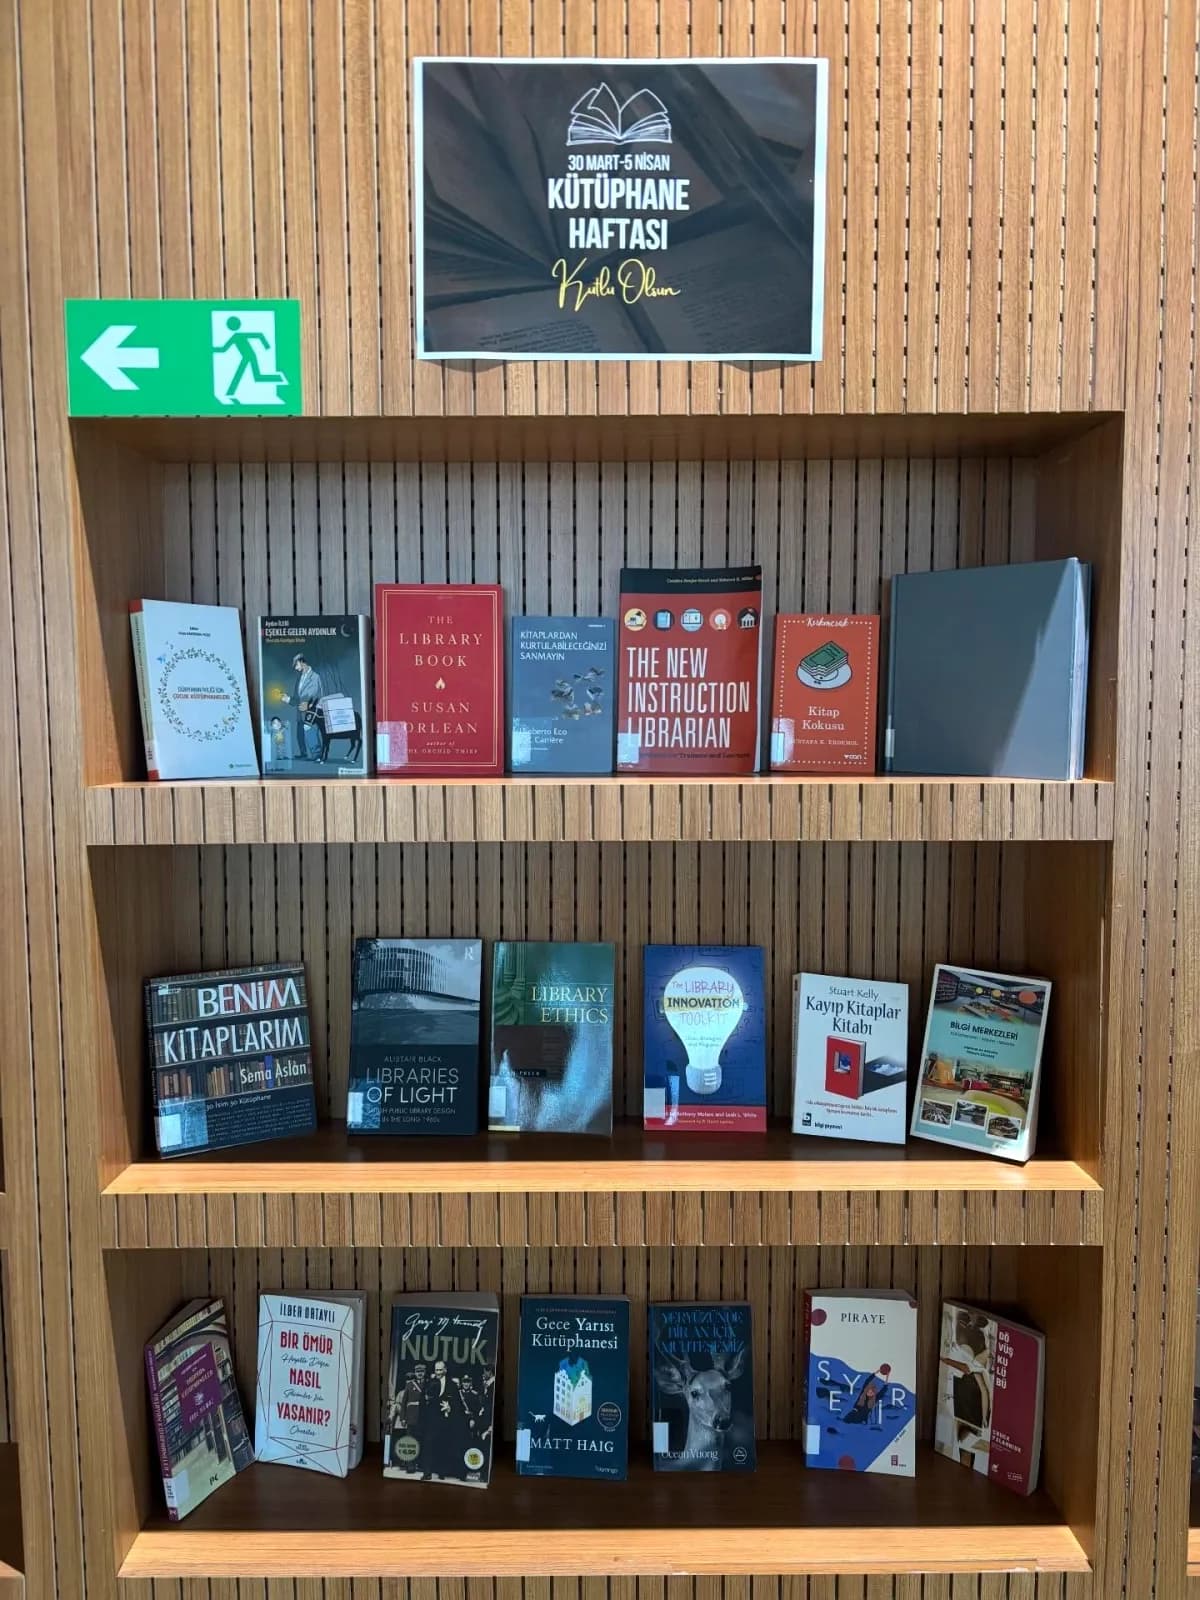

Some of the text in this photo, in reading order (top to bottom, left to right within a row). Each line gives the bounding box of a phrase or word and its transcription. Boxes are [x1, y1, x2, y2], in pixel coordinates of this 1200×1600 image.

[568, 152, 670, 171] 30 MART-5 NİSAN
[547, 173, 690, 211] KÜTÜPHANE
[568, 217, 668, 250] HAFTASI
[551, 257, 681, 312] Kutlu Olsun
[427, 615, 454, 624] THE
[288, 628, 308, 636] GELEN
[308, 628, 337, 636] AYDINLIK
[400, 632, 483, 646] LIBRARY
[520, 630, 578, 640] KİTAPLARDAN
[414, 654, 468, 667] BOOK
[520, 652, 566, 660] SANMAYIN
[626, 647, 708, 679] THE NEW
[628, 681, 750, 714] INSTRUCTION
[411, 702, 470, 713] SUSAN
[808, 706, 840, 718] Kitap
[402, 722, 478, 734] ORLEAN
[553, 728, 568, 736] Eco
[627, 716, 731, 748] LIBRARIAN
[802, 719, 846, 731] Kokusu
[532, 986, 608, 1003] LIBRARY
[672, 980, 735, 998] The LIBRARY
[828, 986, 880, 1002] Stuart Kelly
[197, 977, 300, 1018] BENİM
[667, 996, 740, 1009] INNOVATION
[540, 1006, 609, 1024] ETHICS
[806, 996, 902, 1022] Kayıp Kitaplar
[680, 1012, 728, 1026] TOOLKIT
[832, 1017, 873, 1036] Kitabı
[950, 1020, 970, 1031] BİLGİ
[972, 1025, 1018, 1041] MERKEZLERİ
[163, 1016, 304, 1064] KİTAPLARIM
[418, 1056, 442, 1064] BLACK
[240, 1059, 307, 1085] Sema Aslan
[366, 1067, 460, 1084] LIBRARIES
[366, 1086, 459, 1104] OF LIGHT
[280, 1302, 335, 1324] İLBER ORTAYLI
[840, 1312, 886, 1325] PİRAYE
[536, 1316, 614, 1332] Gece Yarısı
[280, 1329, 333, 1355] BİR ÖMÜR
[532, 1332, 618, 1352] Kütüphanesi
[998, 1331, 1010, 1344] DÖ
[400, 1334, 489, 1366] NUTUK
[998, 1342, 1014, 1358] VÜŞ
[996, 1356, 1008, 1367] KU
[289, 1368, 322, 1390] NASIL
[996, 1366, 1007, 1378] LÜ
[996, 1377, 1007, 1390] BÜ
[530, 1437, 614, 1452] MATT HAIG
